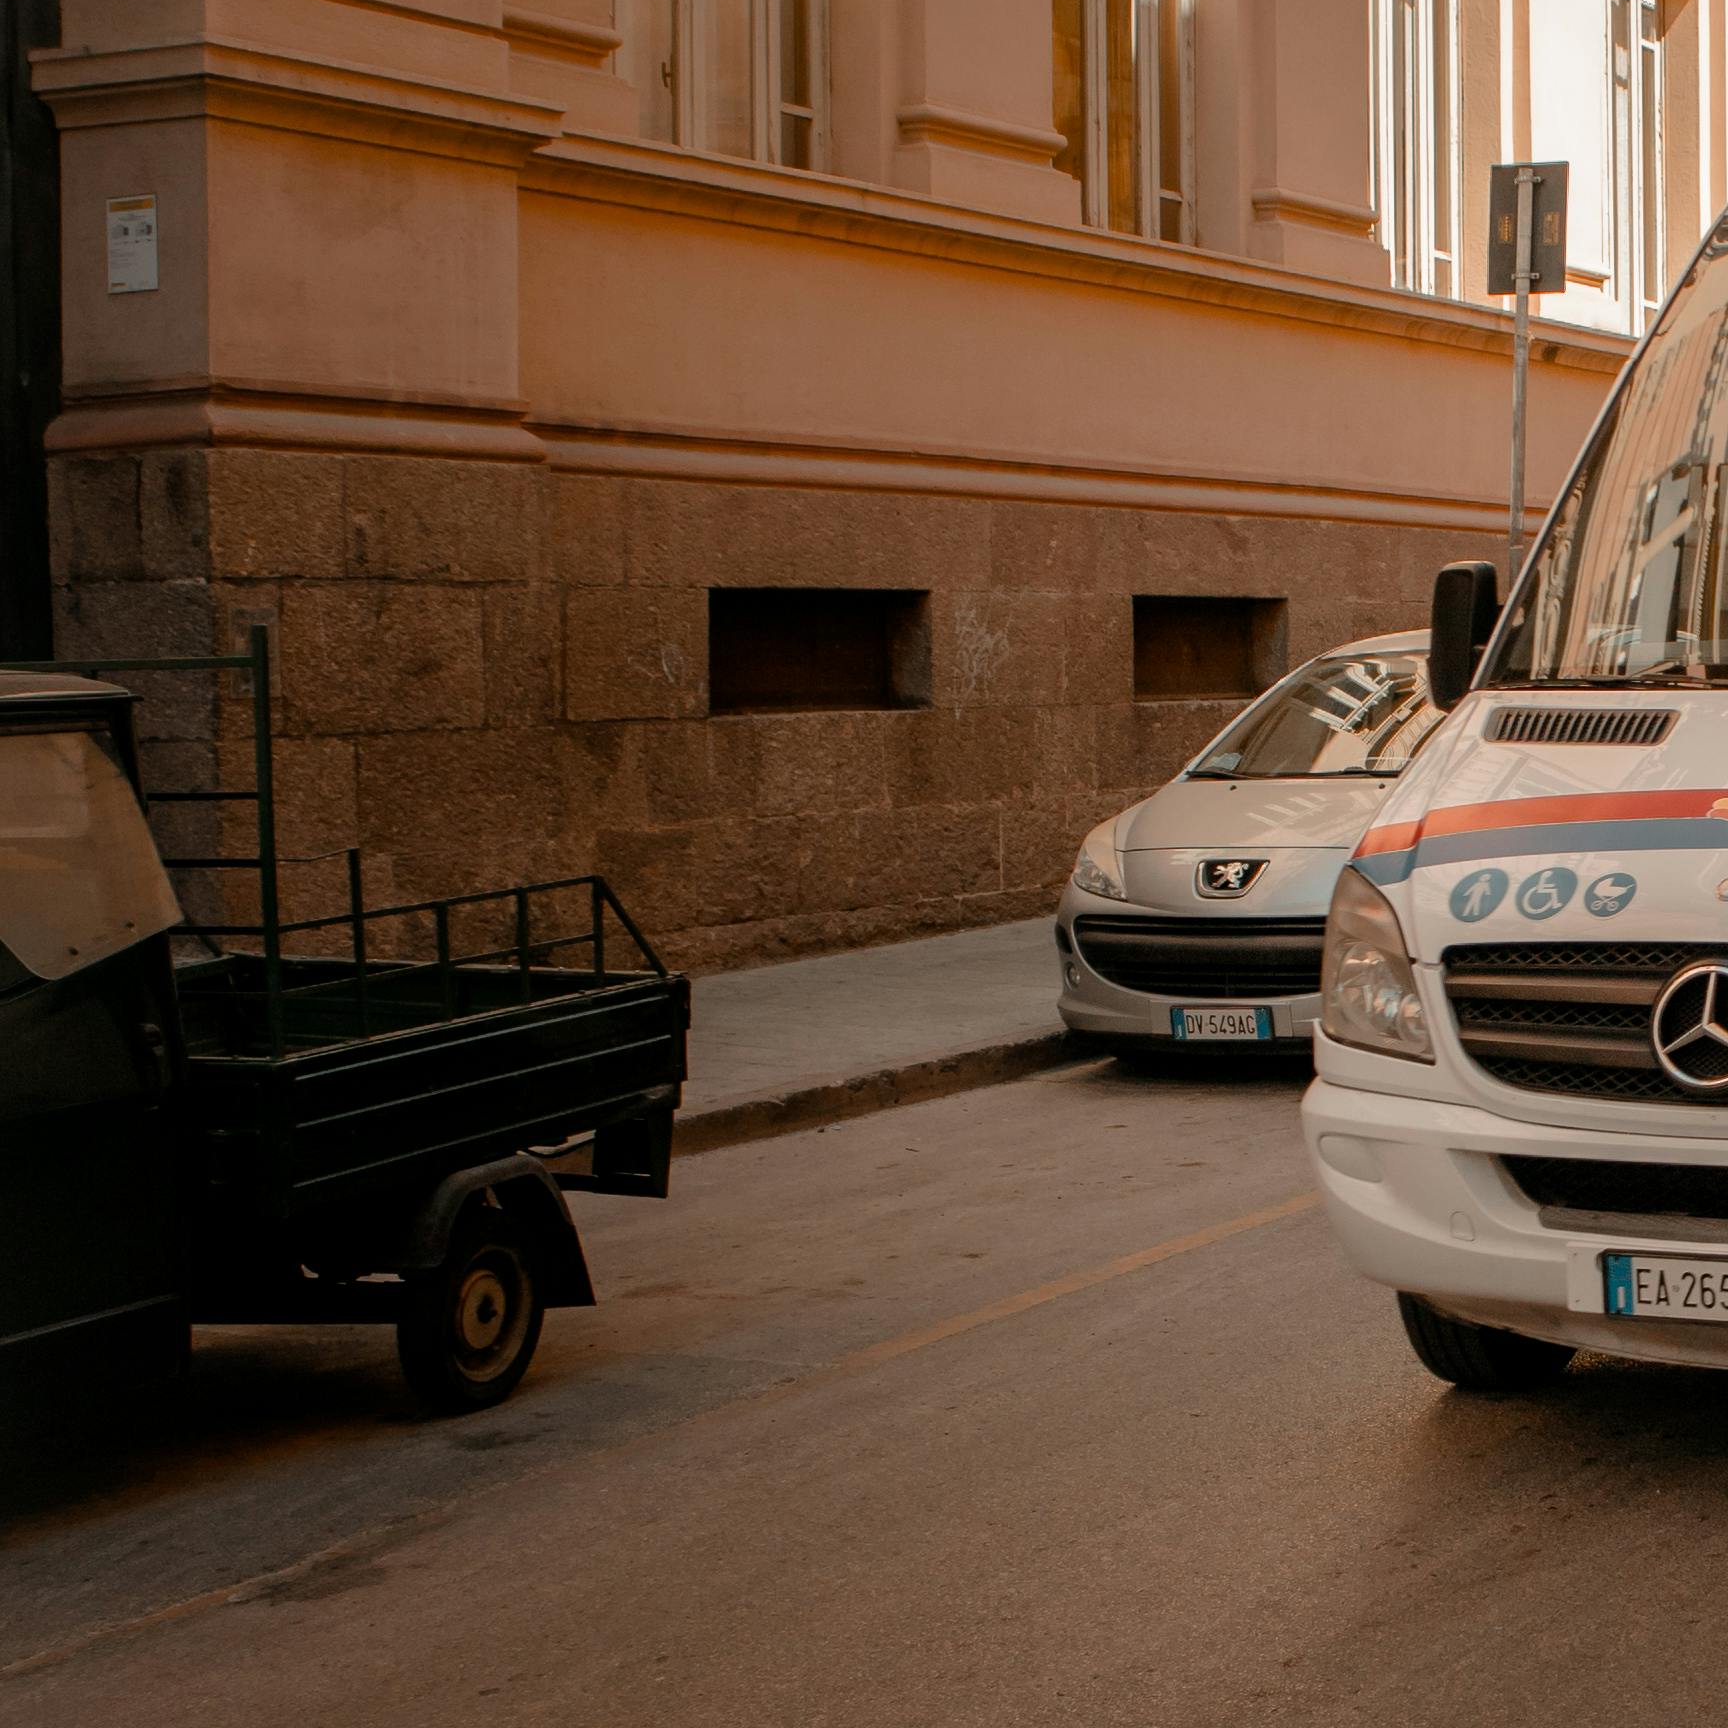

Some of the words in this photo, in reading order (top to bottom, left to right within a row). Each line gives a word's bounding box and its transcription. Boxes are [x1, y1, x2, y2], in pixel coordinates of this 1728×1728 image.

[1185, 1014, 1203, 1035] DV
[1209, 1014, 1256, 1035] 549AG
[1636, 1268, 1670, 1306] EA
